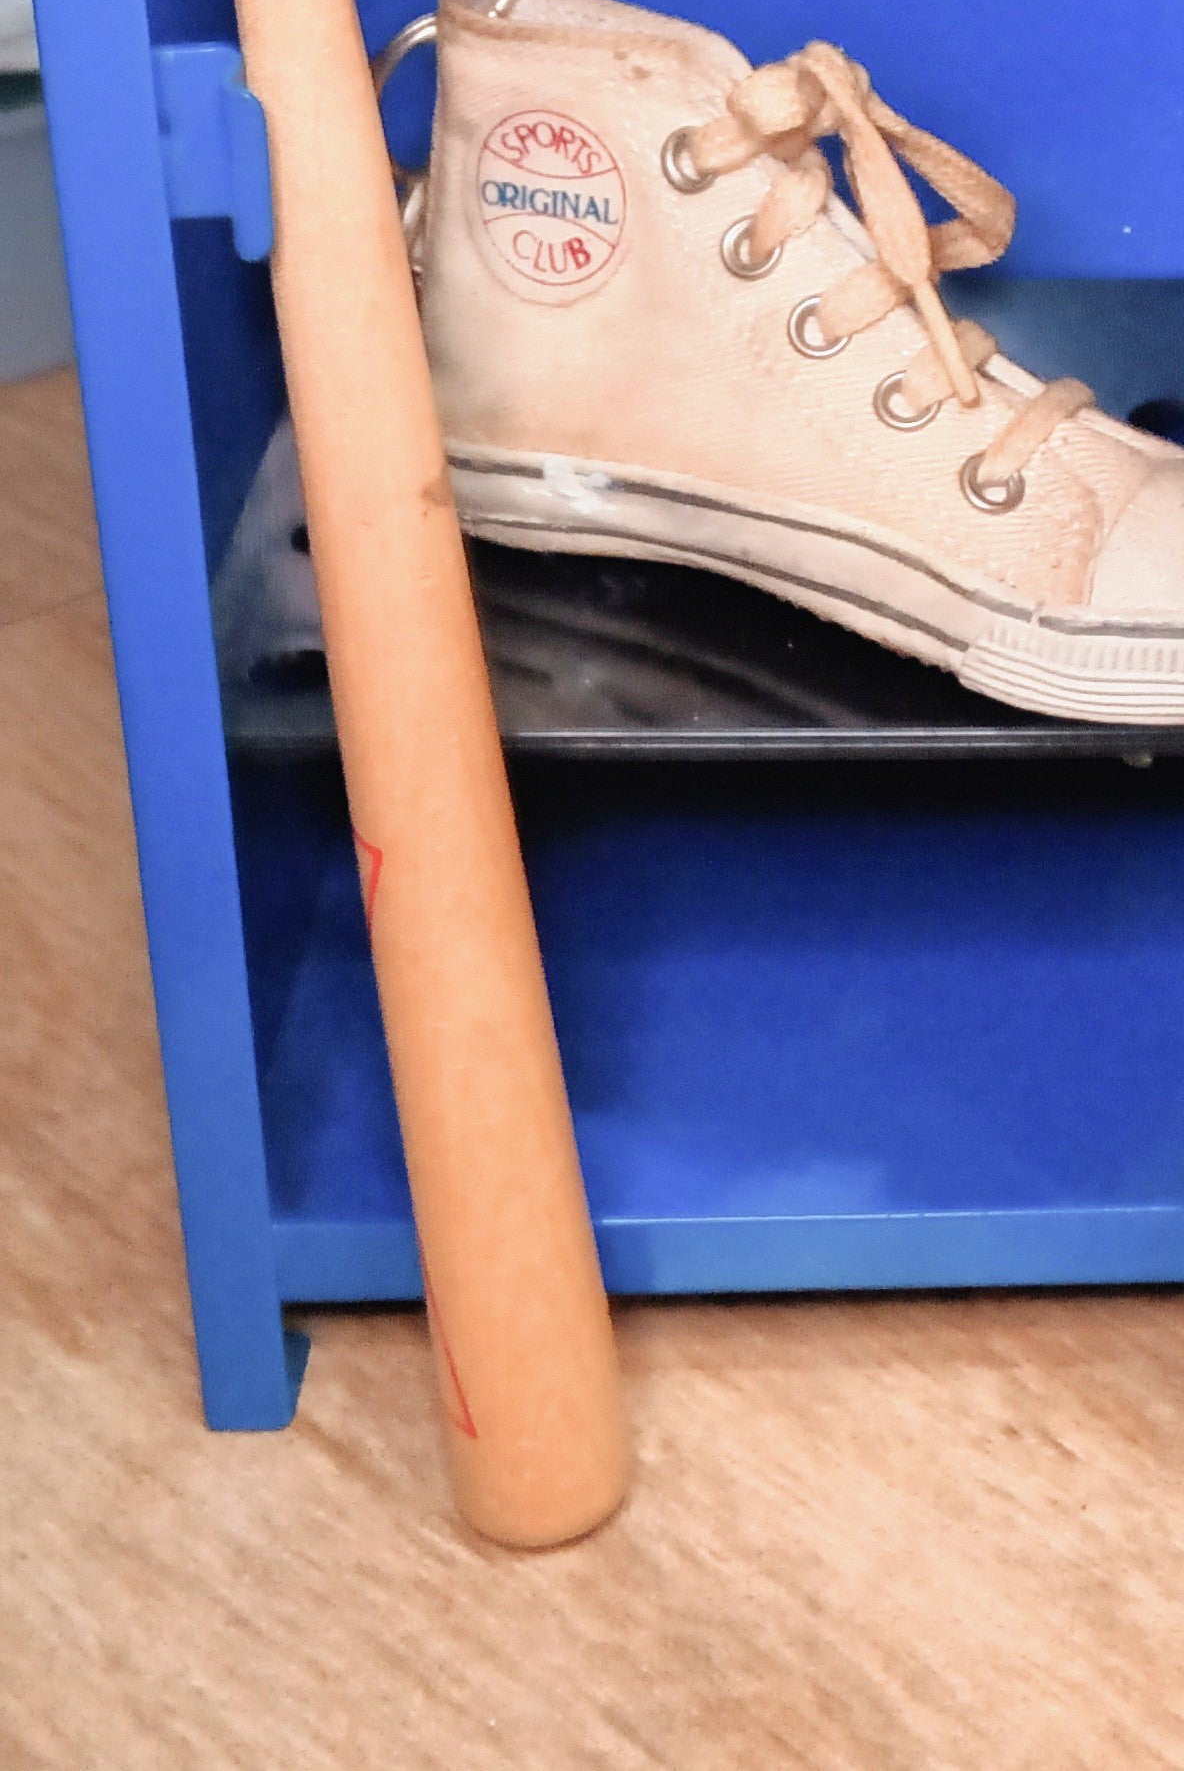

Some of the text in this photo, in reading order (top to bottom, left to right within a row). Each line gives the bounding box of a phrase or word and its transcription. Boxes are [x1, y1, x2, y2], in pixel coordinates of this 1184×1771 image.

[501, 120, 602, 177] SPORTS
[481, 179, 619, 225] ORIGINAL
[512, 229, 592, 275] CLUB
